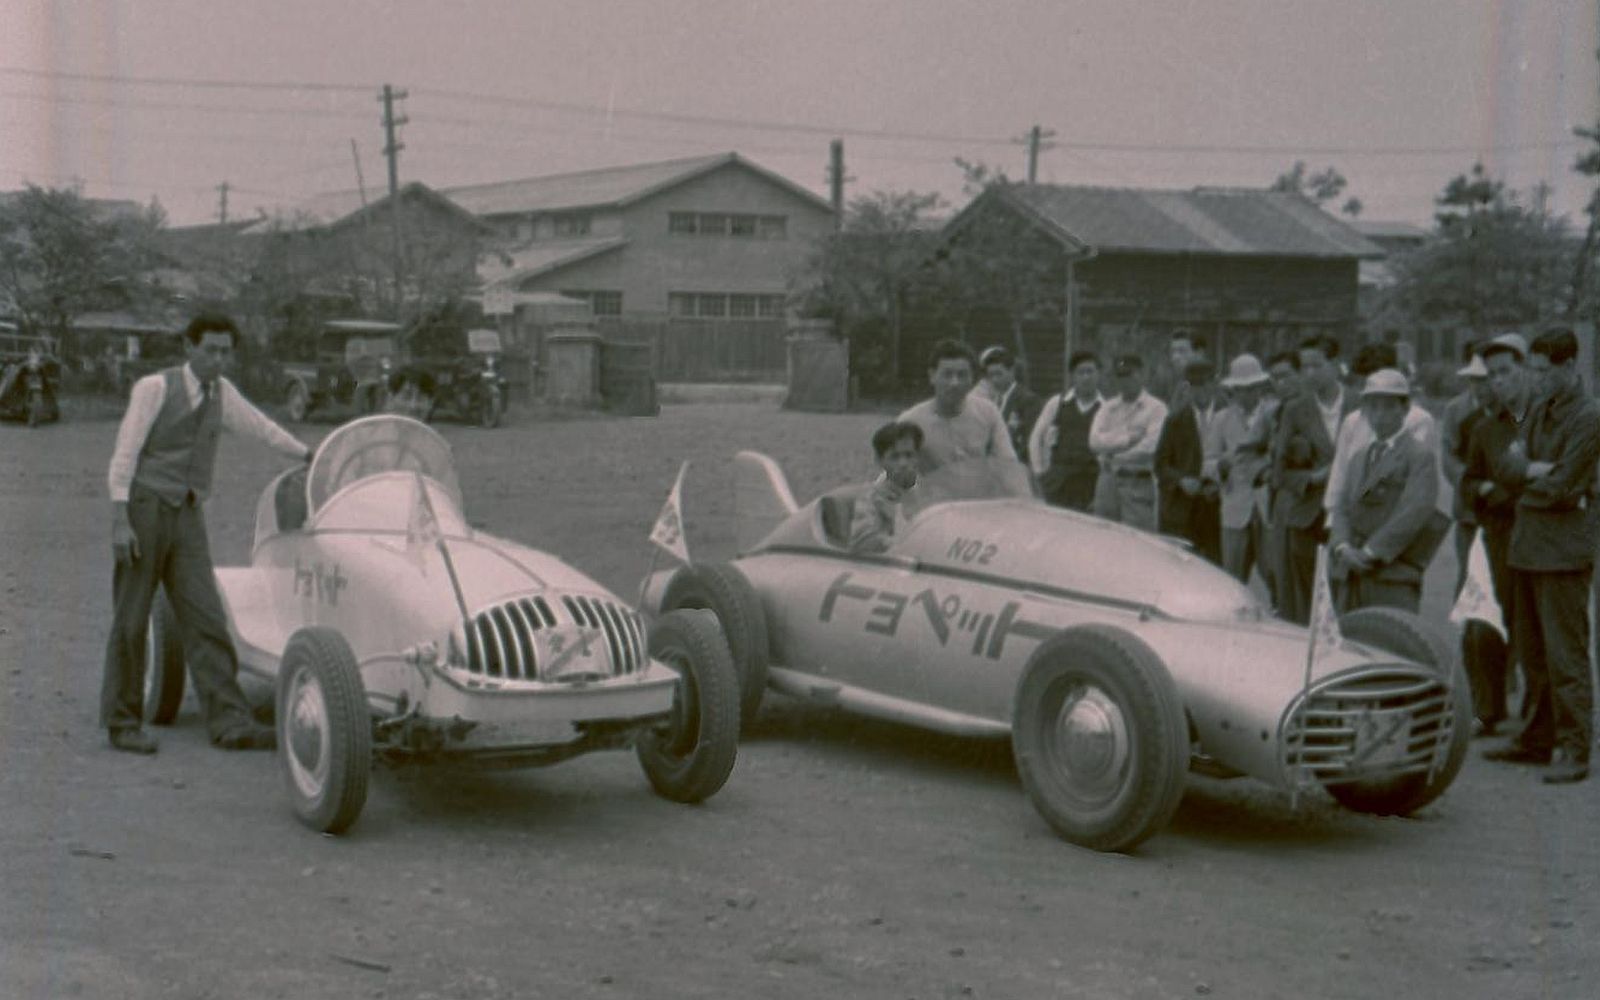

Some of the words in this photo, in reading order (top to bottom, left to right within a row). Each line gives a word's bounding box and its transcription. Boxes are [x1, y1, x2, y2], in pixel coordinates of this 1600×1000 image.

[818, 571, 1062, 661] トヨペット
